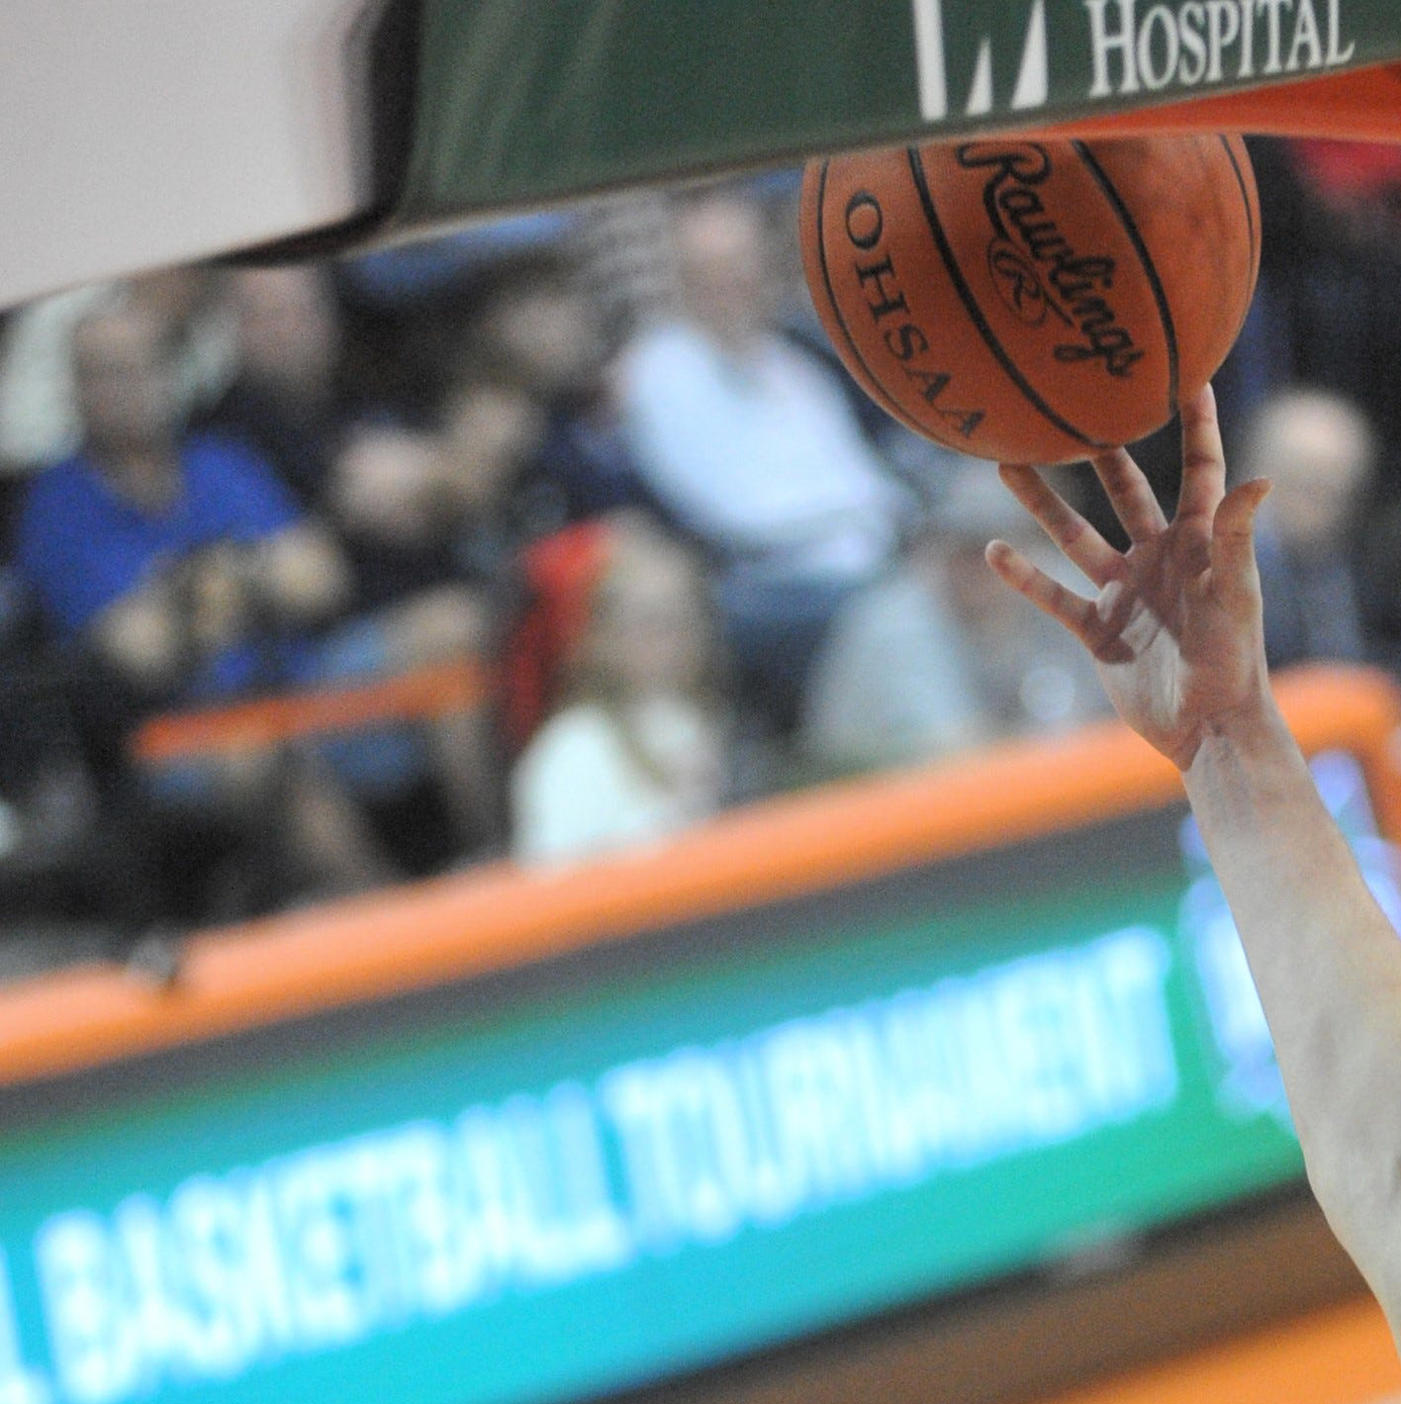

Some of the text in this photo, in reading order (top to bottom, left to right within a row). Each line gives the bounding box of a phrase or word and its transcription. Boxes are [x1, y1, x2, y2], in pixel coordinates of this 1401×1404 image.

[1086, 0, 1355, 98] HOSPITAL
[844, 192, 987, 438] OHSAA
[956, 140, 1146, 378] Rawlings
[600, 926, 1180, 1258] TOURNAMENT
